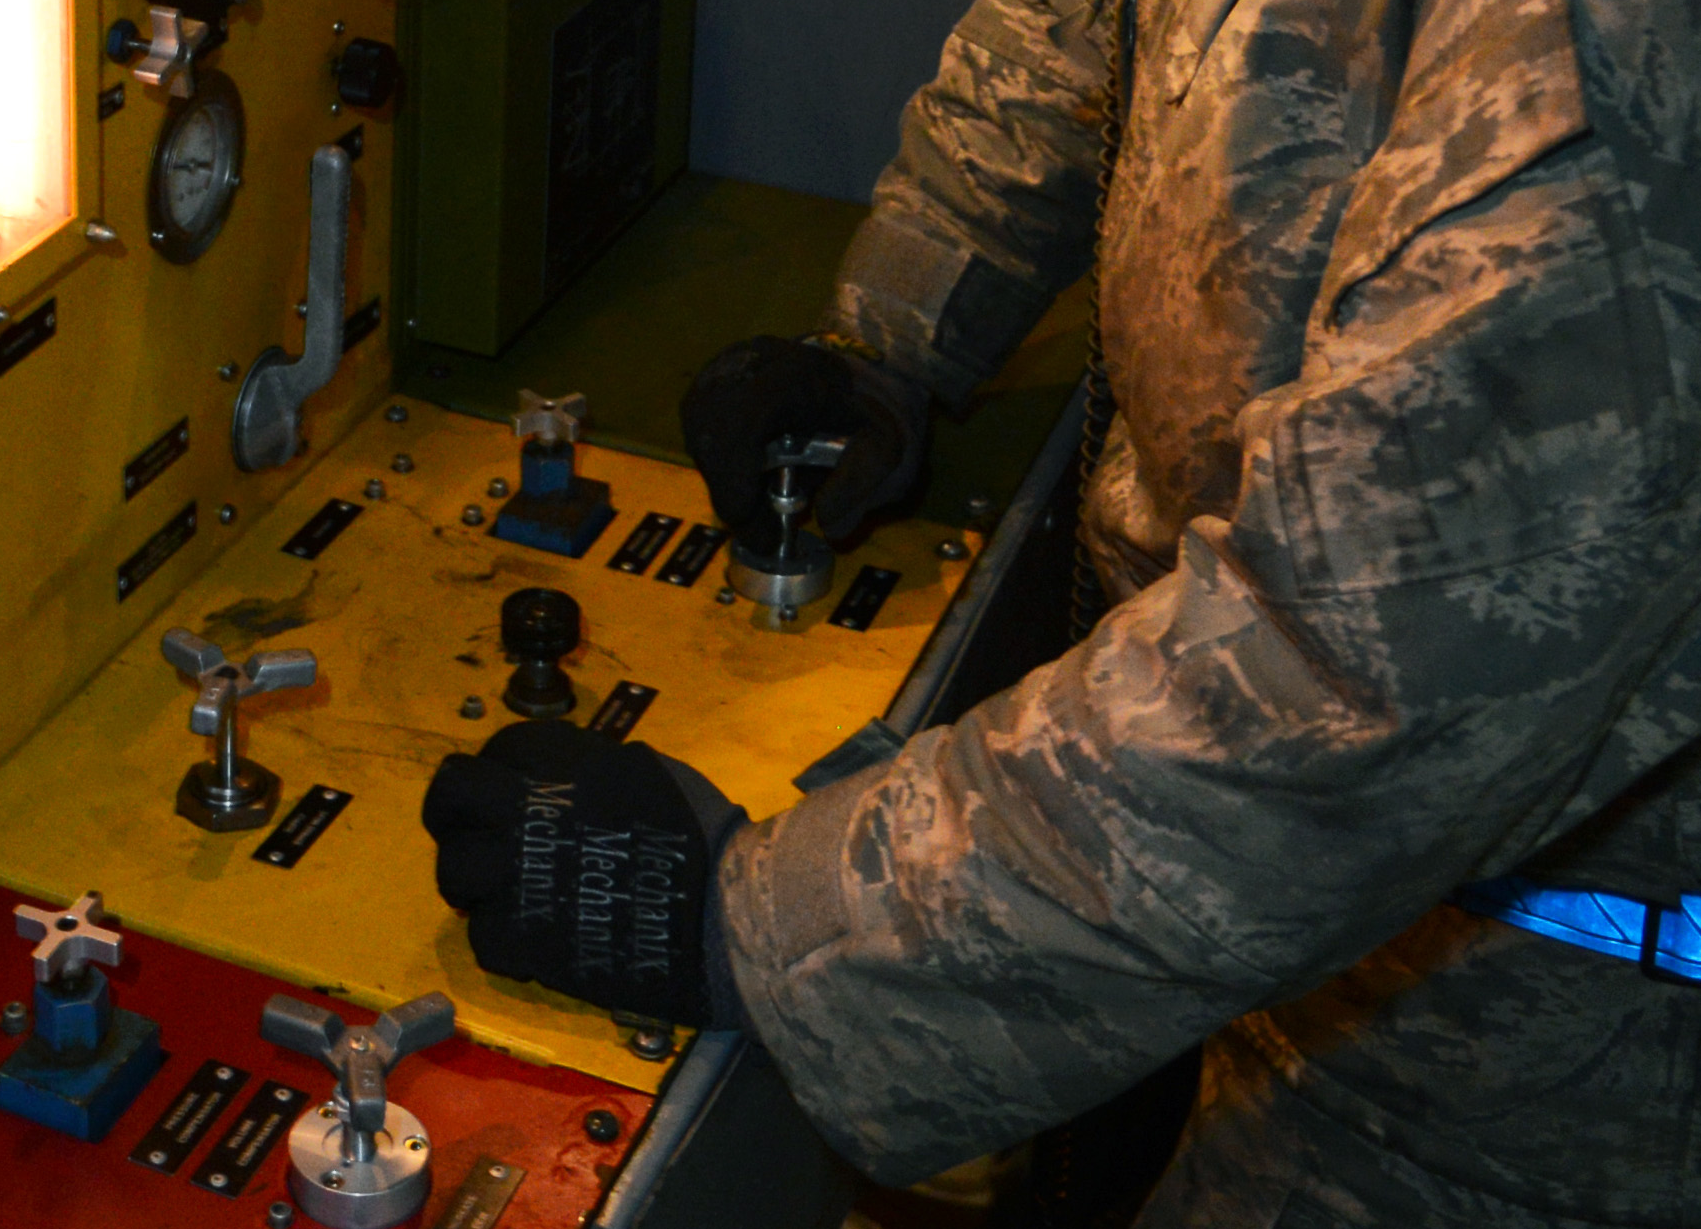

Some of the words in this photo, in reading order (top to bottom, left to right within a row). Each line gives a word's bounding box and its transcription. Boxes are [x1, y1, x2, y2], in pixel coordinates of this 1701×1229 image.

[521, 776, 576, 921] Mechanix
[577, 824, 632, 972] Mechanix
[632, 822, 688, 976] Mechanix
